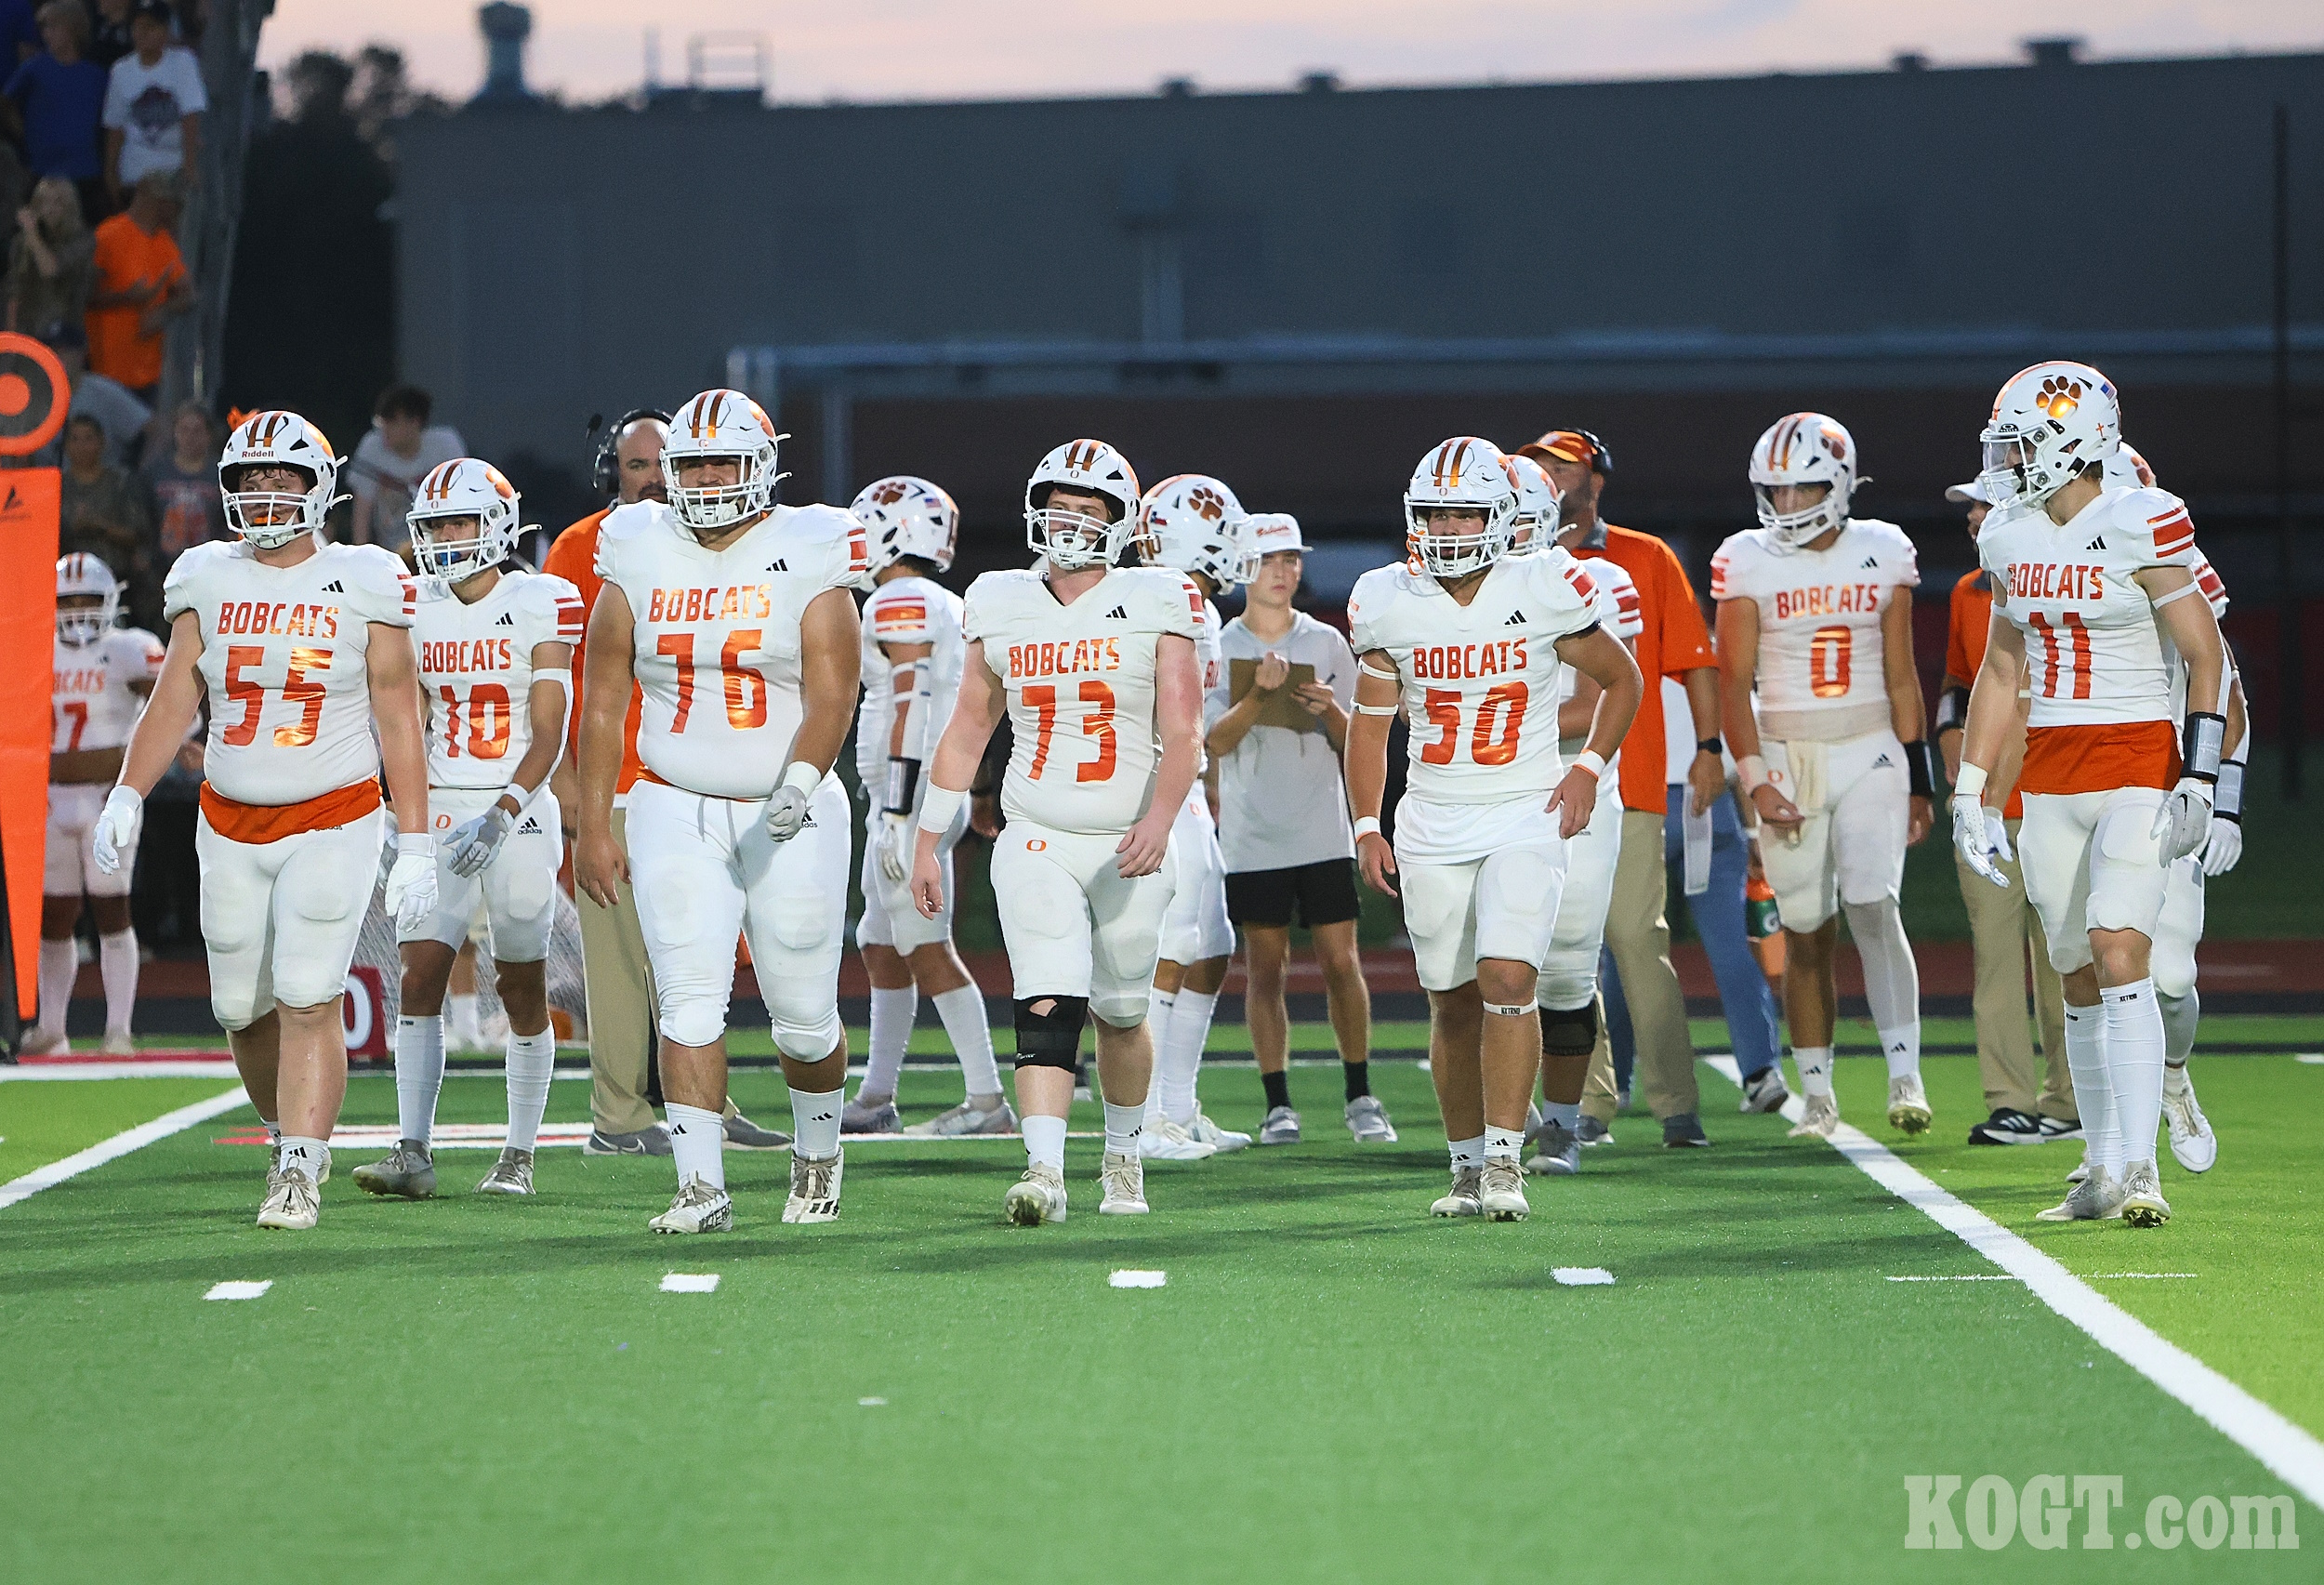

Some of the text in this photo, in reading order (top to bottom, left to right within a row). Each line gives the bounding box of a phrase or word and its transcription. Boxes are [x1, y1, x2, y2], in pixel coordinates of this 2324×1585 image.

[242, 450, 274, 458] Riddell
[1776, 584, 1879, 620] BOBCATS
[2008, 562, 2105, 600] BOBCATS
[217, 601, 340, 639] BOBCATS
[648, 583, 772, 623] BOBCATS
[422, 638, 512, 673] BOBCATS
[1009, 636, 1121, 678] BOBCATS
[1413, 637, 1527, 680] BOBCATS
[1810, 624, 1852, 698] 0
[2028, 611, 2093, 700] 11
[222, 644, 335, 747] 55
[656, 628, 768, 734] 76
[439, 682, 510, 759] 10
[1021, 680, 1117, 783] 73
[1420, 680, 1529, 766] 50
[517, 826, 543, 835] adidas
